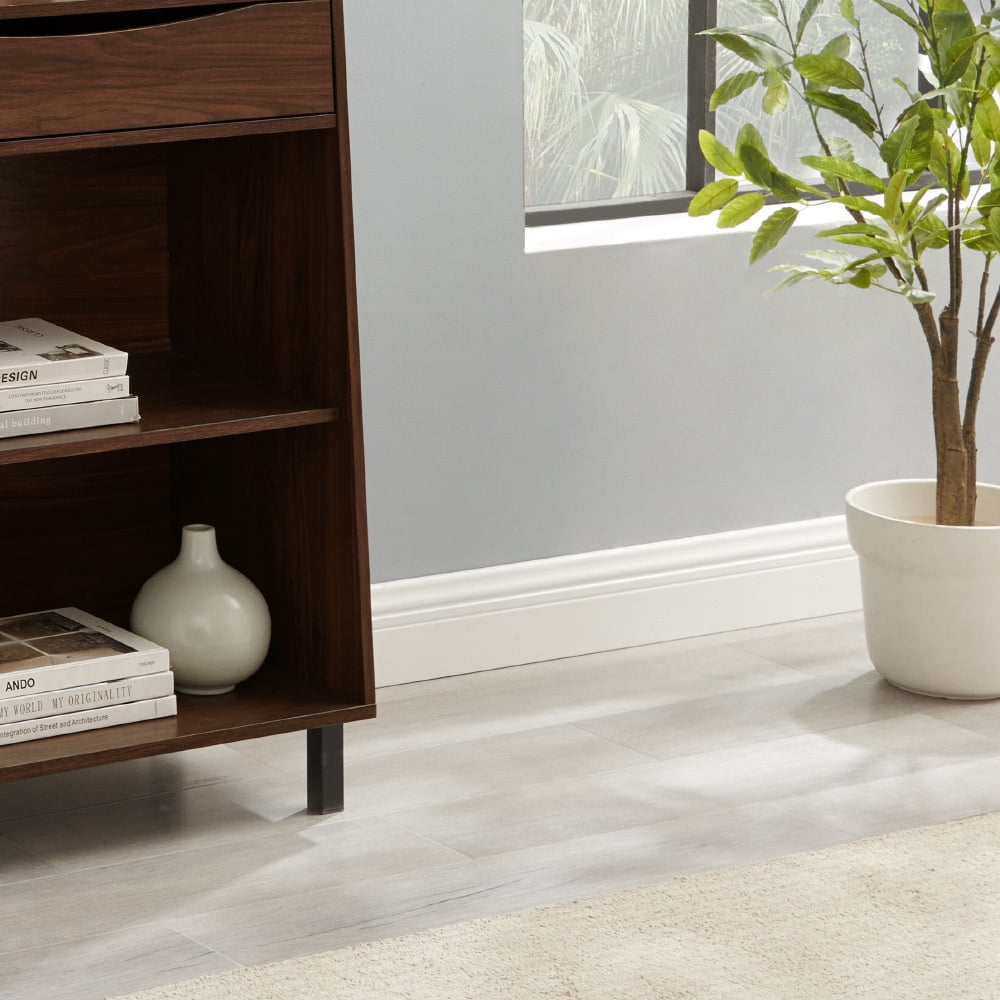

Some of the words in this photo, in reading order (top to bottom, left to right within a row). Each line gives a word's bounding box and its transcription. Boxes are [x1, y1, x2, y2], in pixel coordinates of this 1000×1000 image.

[11, 416, 52, 428] building
[5, 677, 36, 692] ANDO
[13, 701, 43, 715] WORLD
[52, 697, 64, 709] MY
[68, 685, 133, 705] ORIGINALITY
[32, 725, 40, 733] of
[40, 721, 58, 731] Street
[60, 720, 71, 728] and
[71, 714, 109, 725] Architecture
